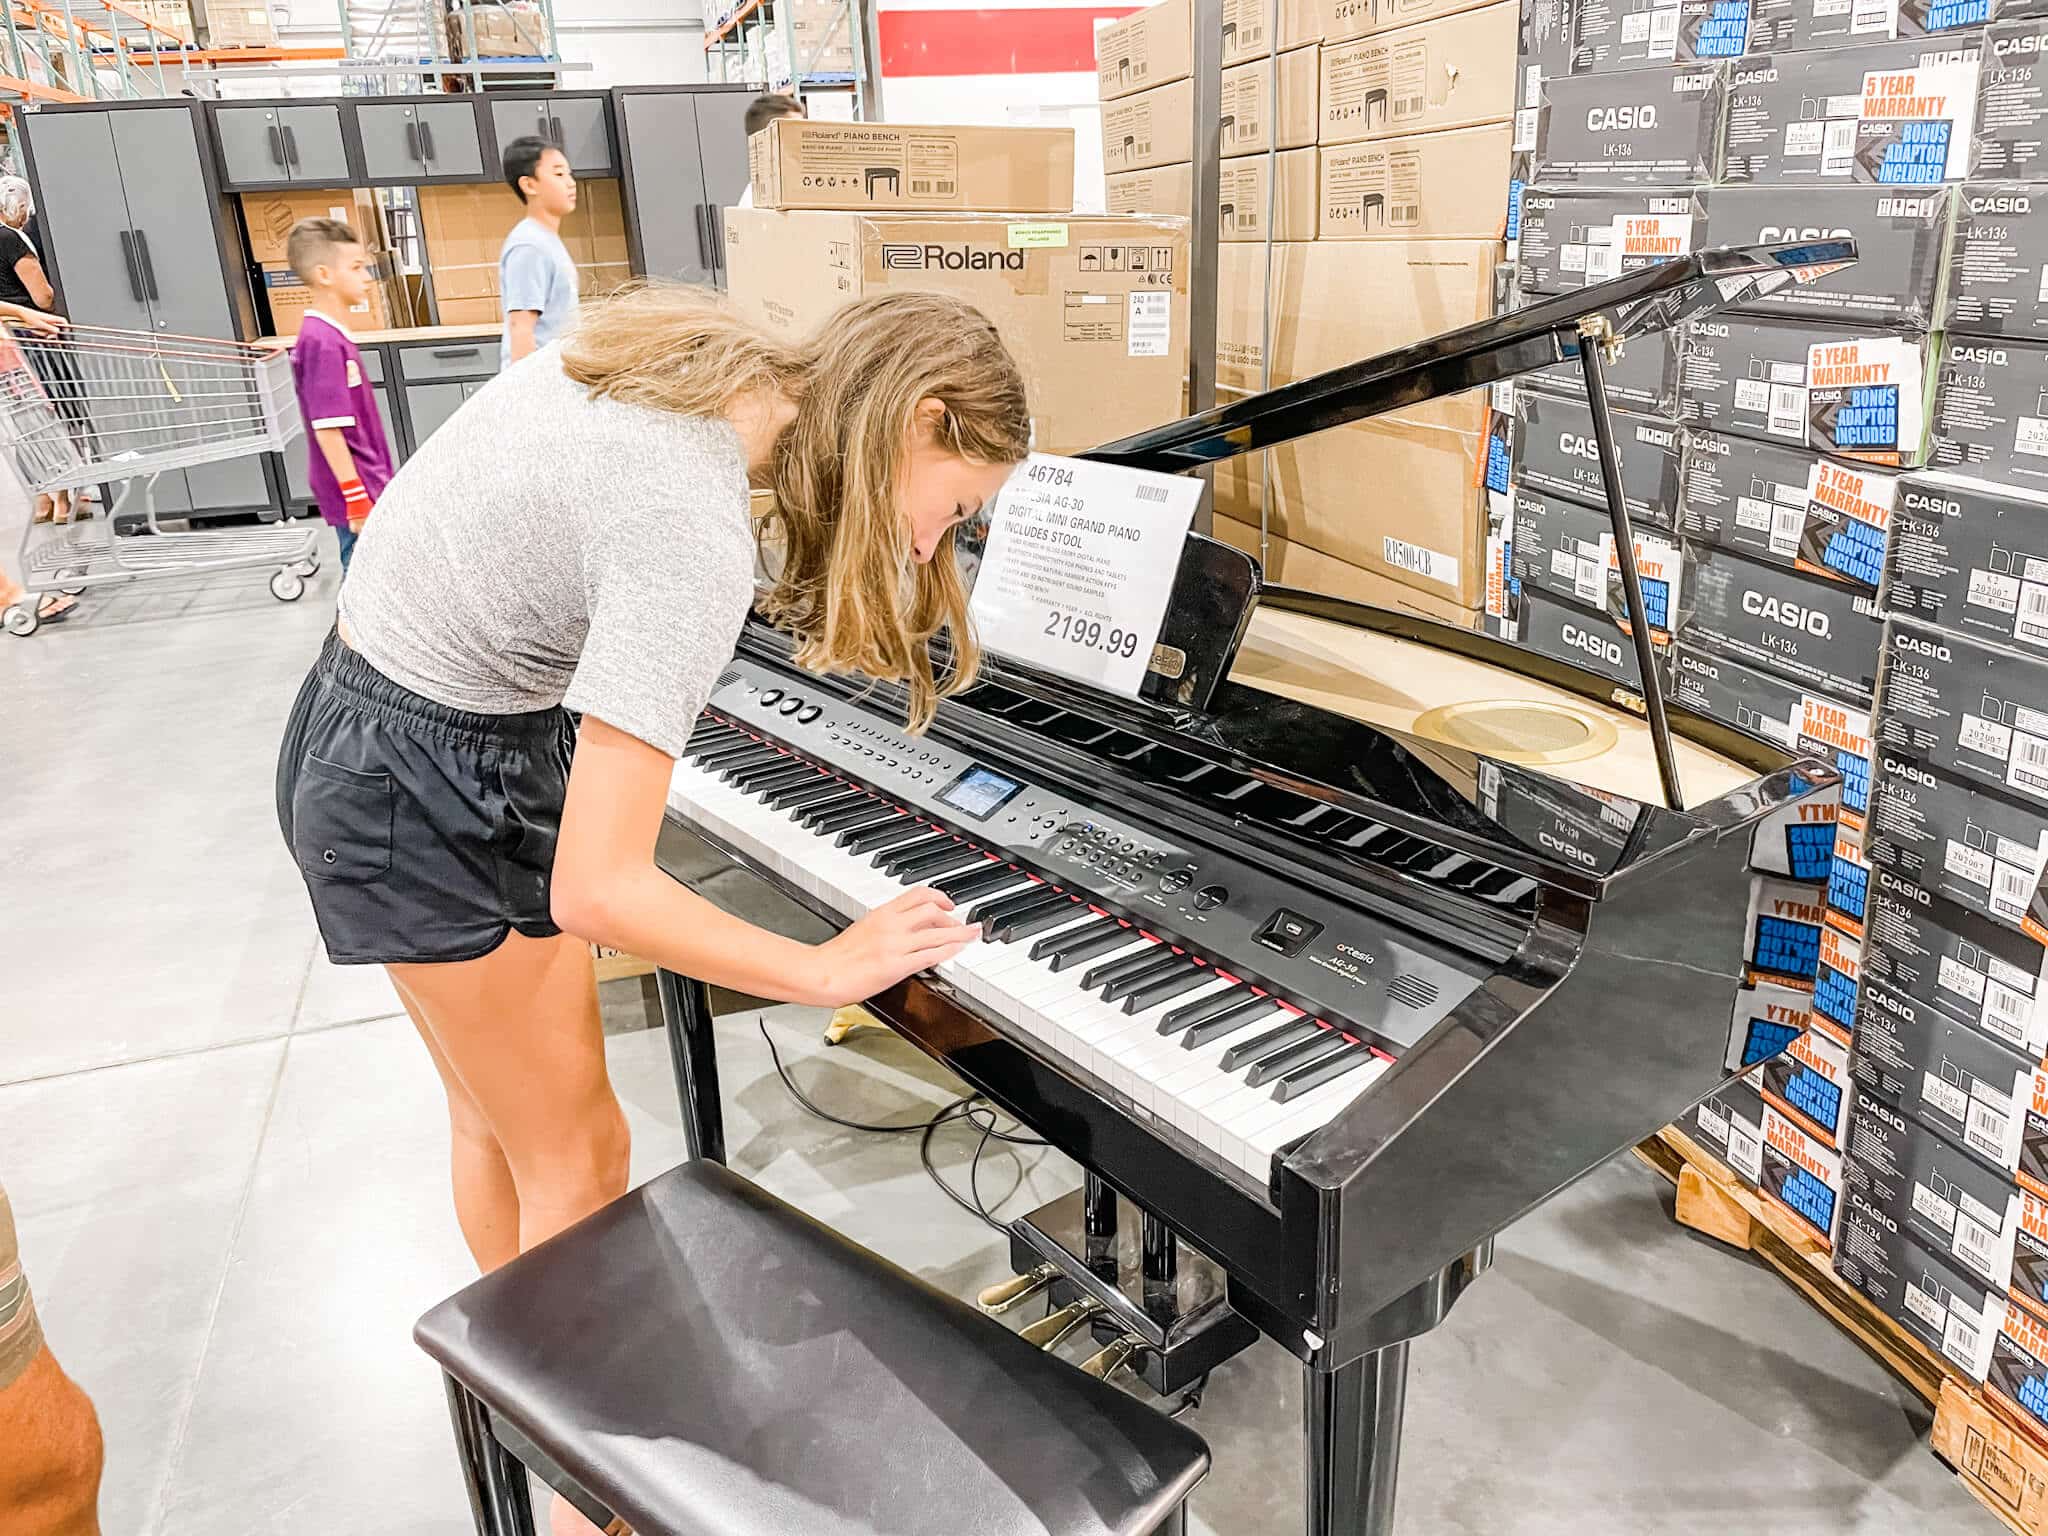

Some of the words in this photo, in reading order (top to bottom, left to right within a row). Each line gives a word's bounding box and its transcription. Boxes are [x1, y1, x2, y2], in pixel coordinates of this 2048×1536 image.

[1714, 2, 1748, 19] BONUS
[1700, 20, 1744, 38] ADAPTOR
[1696, 37, 1743, 55] INCLUDED
[1735, 69, 1776, 85] CASIO
[1866, 76, 1876, 97] 5
[1880, 75, 1915, 96] YEAR
[1990, 67, 2032, 84] LK-136
[1587, 105, 1657, 131] CASIO
[1863, 96, 1946, 118] WARRANTY
[843, 132, 870, 141] PIANO
[872, 133, 900, 141] BENCH
[1859, 123, 1892, 134] CASIO
[1902, 123, 1949, 144] BONUS
[1603, 143, 1632, 157] LK-136
[1885, 144, 1946, 164] ADAPTOR
[1878, 163, 1944, 183] INCLUDED
[1526, 198, 1555, 210] CASIO
[1970, 197, 2032, 213] CASIO
[1626, 220, 1633, 235] 5
[1634, 220, 1660, 236] YEAR
[1967, 226, 2008, 239] LK-136
[924, 245, 1024, 270] Roland
[1625, 237, 1682, 254] WARRANTY
[1690, 322, 1729, 337] CASIO
[1812, 349, 1822, 366] 5
[1825, 346, 1858, 365] YEAR
[1951, 346, 2008, 366] CASIO
[1812, 364, 1890, 385] WARRANTY
[1948, 373, 1986, 389] LK-136
[1811, 390, 1842, 401] CASIO
[1852, 388, 1896, 407] BONUS
[1837, 407, 1895, 426] ADAPTOR
[1692, 437, 1730, 456] CASIO
[1835, 426, 1895, 445] INCLUDED
[1028, 465, 1074, 487] 46784
[1818, 465, 1829, 481] 5
[1831, 468, 1864, 496] YEAR
[1053, 495, 1084, 511] AG-30
[1518, 499, 1546, 515] CASIO
[1809, 504, 1839, 521] CASIO
[1814, 482, 1889, 527] WARRANTY
[1905, 493, 1962, 518] CASIO
[1004, 520, 1049, 540] INCLUDES
[1050, 531, 1083, 549] STOOL
[1046, 511, 1068, 527] MINI
[1070, 517, 1105, 534] GRAND
[1107, 524, 1141, 541] PIANO
[1846, 519, 1887, 550] BONUS
[1901, 518, 1940, 538] LK-136
[1384, 538, 1433, 575] RP500-CB
[1829, 533, 1885, 568] ADAPTOR
[1610, 553, 1664, 578] WANTY
[1823, 549, 1881, 586] INCLUDED
[1641, 578, 1667, 597] ONUS
[1742, 590, 1832, 640] CASIO
[1044, 610, 1138, 658] 2199.99
[1561, 623, 1623, 667] CASIO
[1761, 631, 1798, 656] LK-136
[1895, 634, 1952, 663] CASIO
[1681, 655, 1719, 681] CASIO
[1893, 658, 1930, 680] LK-136
[1804, 700, 1813, 717] 5
[1816, 703, 1847, 730] YEAR
[1799, 737, 1829, 755] CASIO
[1837, 751, 1871, 778] BONU
[1883, 757, 1937, 789] CASIO
[1881, 780, 1918, 804] LK-136
[1879, 872, 1931, 905] CASIO
[1877, 896, 1912, 920] LK-136
[1865, 986, 1916, 1024] CASIO
[1863, 1006, 1897, 1035] LK-136
[1789, 1074, 1838, 1116] ADAPTOR
[1802, 1066, 1840, 1101] BONUS
[2034, 1074, 2045, 1093] 5
[1785, 1085, 1836, 1130] INCLUDED
[1858, 1094, 1907, 1134] CASIO
[1767, 1115, 1776, 1129] 5
[1778, 1120, 1806, 1149] YEAR
[1855, 1113, 1889, 1142] LK-136
[1764, 1145, 1791, 1169] CASIO
[1766, 1129, 1831, 1182] WARRANTY
[1786, 1175, 1831, 1219] ADAPTOR
[1798, 1169, 1833, 1204] BONUS
[1781, 1186, 1830, 1233] INCLUDED
[1851, 1193, 1898, 1234] CASIO
[2023, 1194, 2034, 1213] 5
[1849, 1211, 1882, 1242] LK-136
[2006, 1304, 2016, 1319] 5
[1999, 1335, 2035, 1368] CASIO
